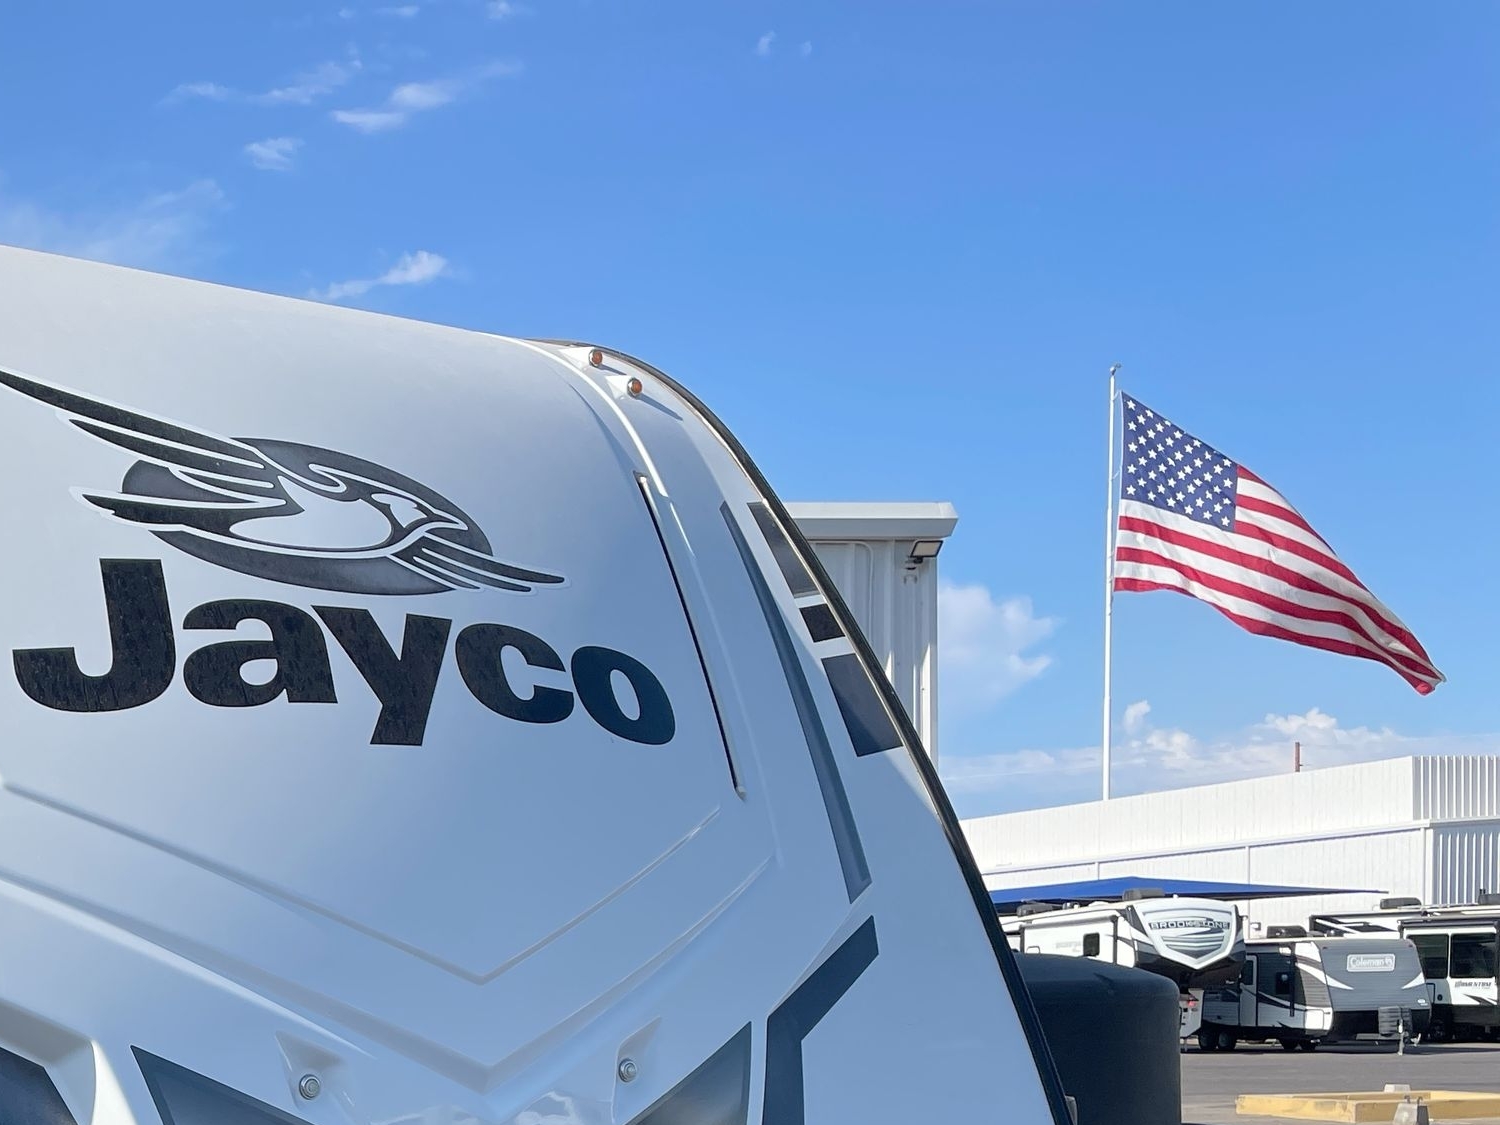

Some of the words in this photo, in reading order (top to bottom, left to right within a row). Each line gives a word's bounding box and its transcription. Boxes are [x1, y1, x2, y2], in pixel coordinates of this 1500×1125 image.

[12, 558, 676, 746] Jayco
[1150, 920, 1230, 930] BROOKSTONE
[1350, 956, 1385, 968] Coleman
